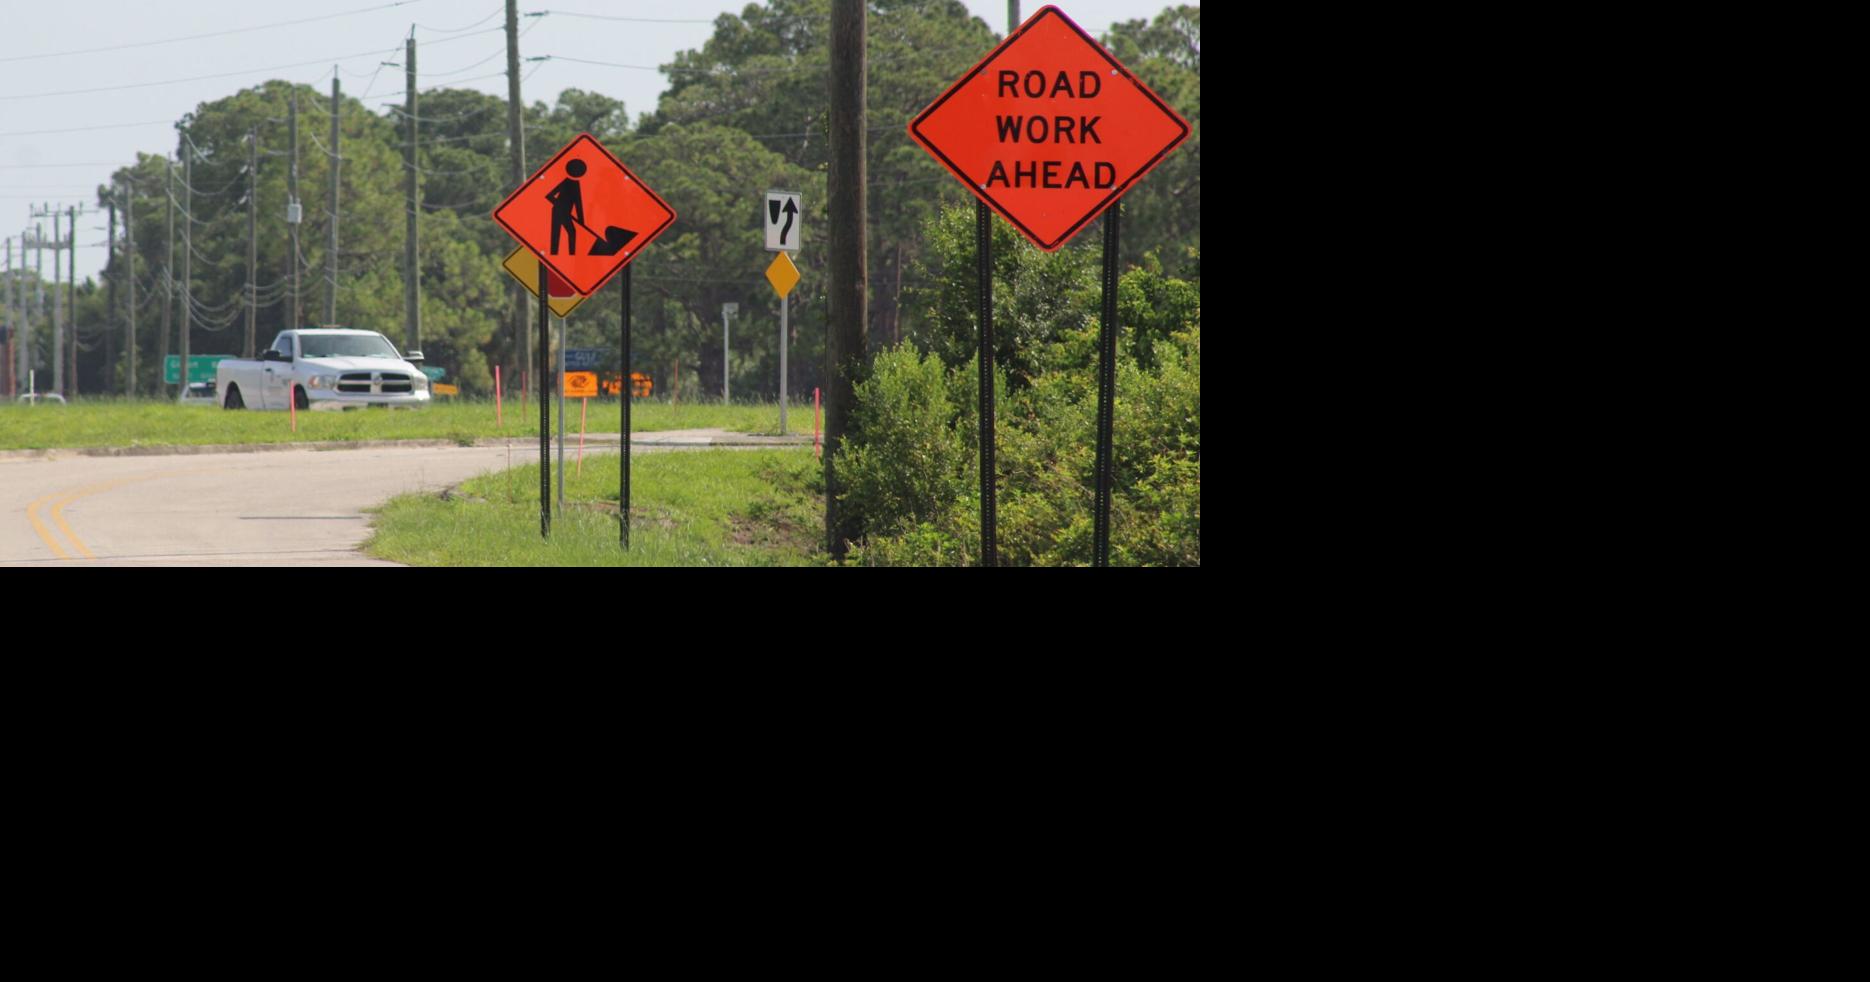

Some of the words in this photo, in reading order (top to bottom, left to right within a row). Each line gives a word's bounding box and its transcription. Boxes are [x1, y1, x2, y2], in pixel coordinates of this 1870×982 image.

[998, 70, 1101, 98] ROAD
[996, 116, 1102, 144] WORK
[986, 161, 1117, 189] AHEAD
